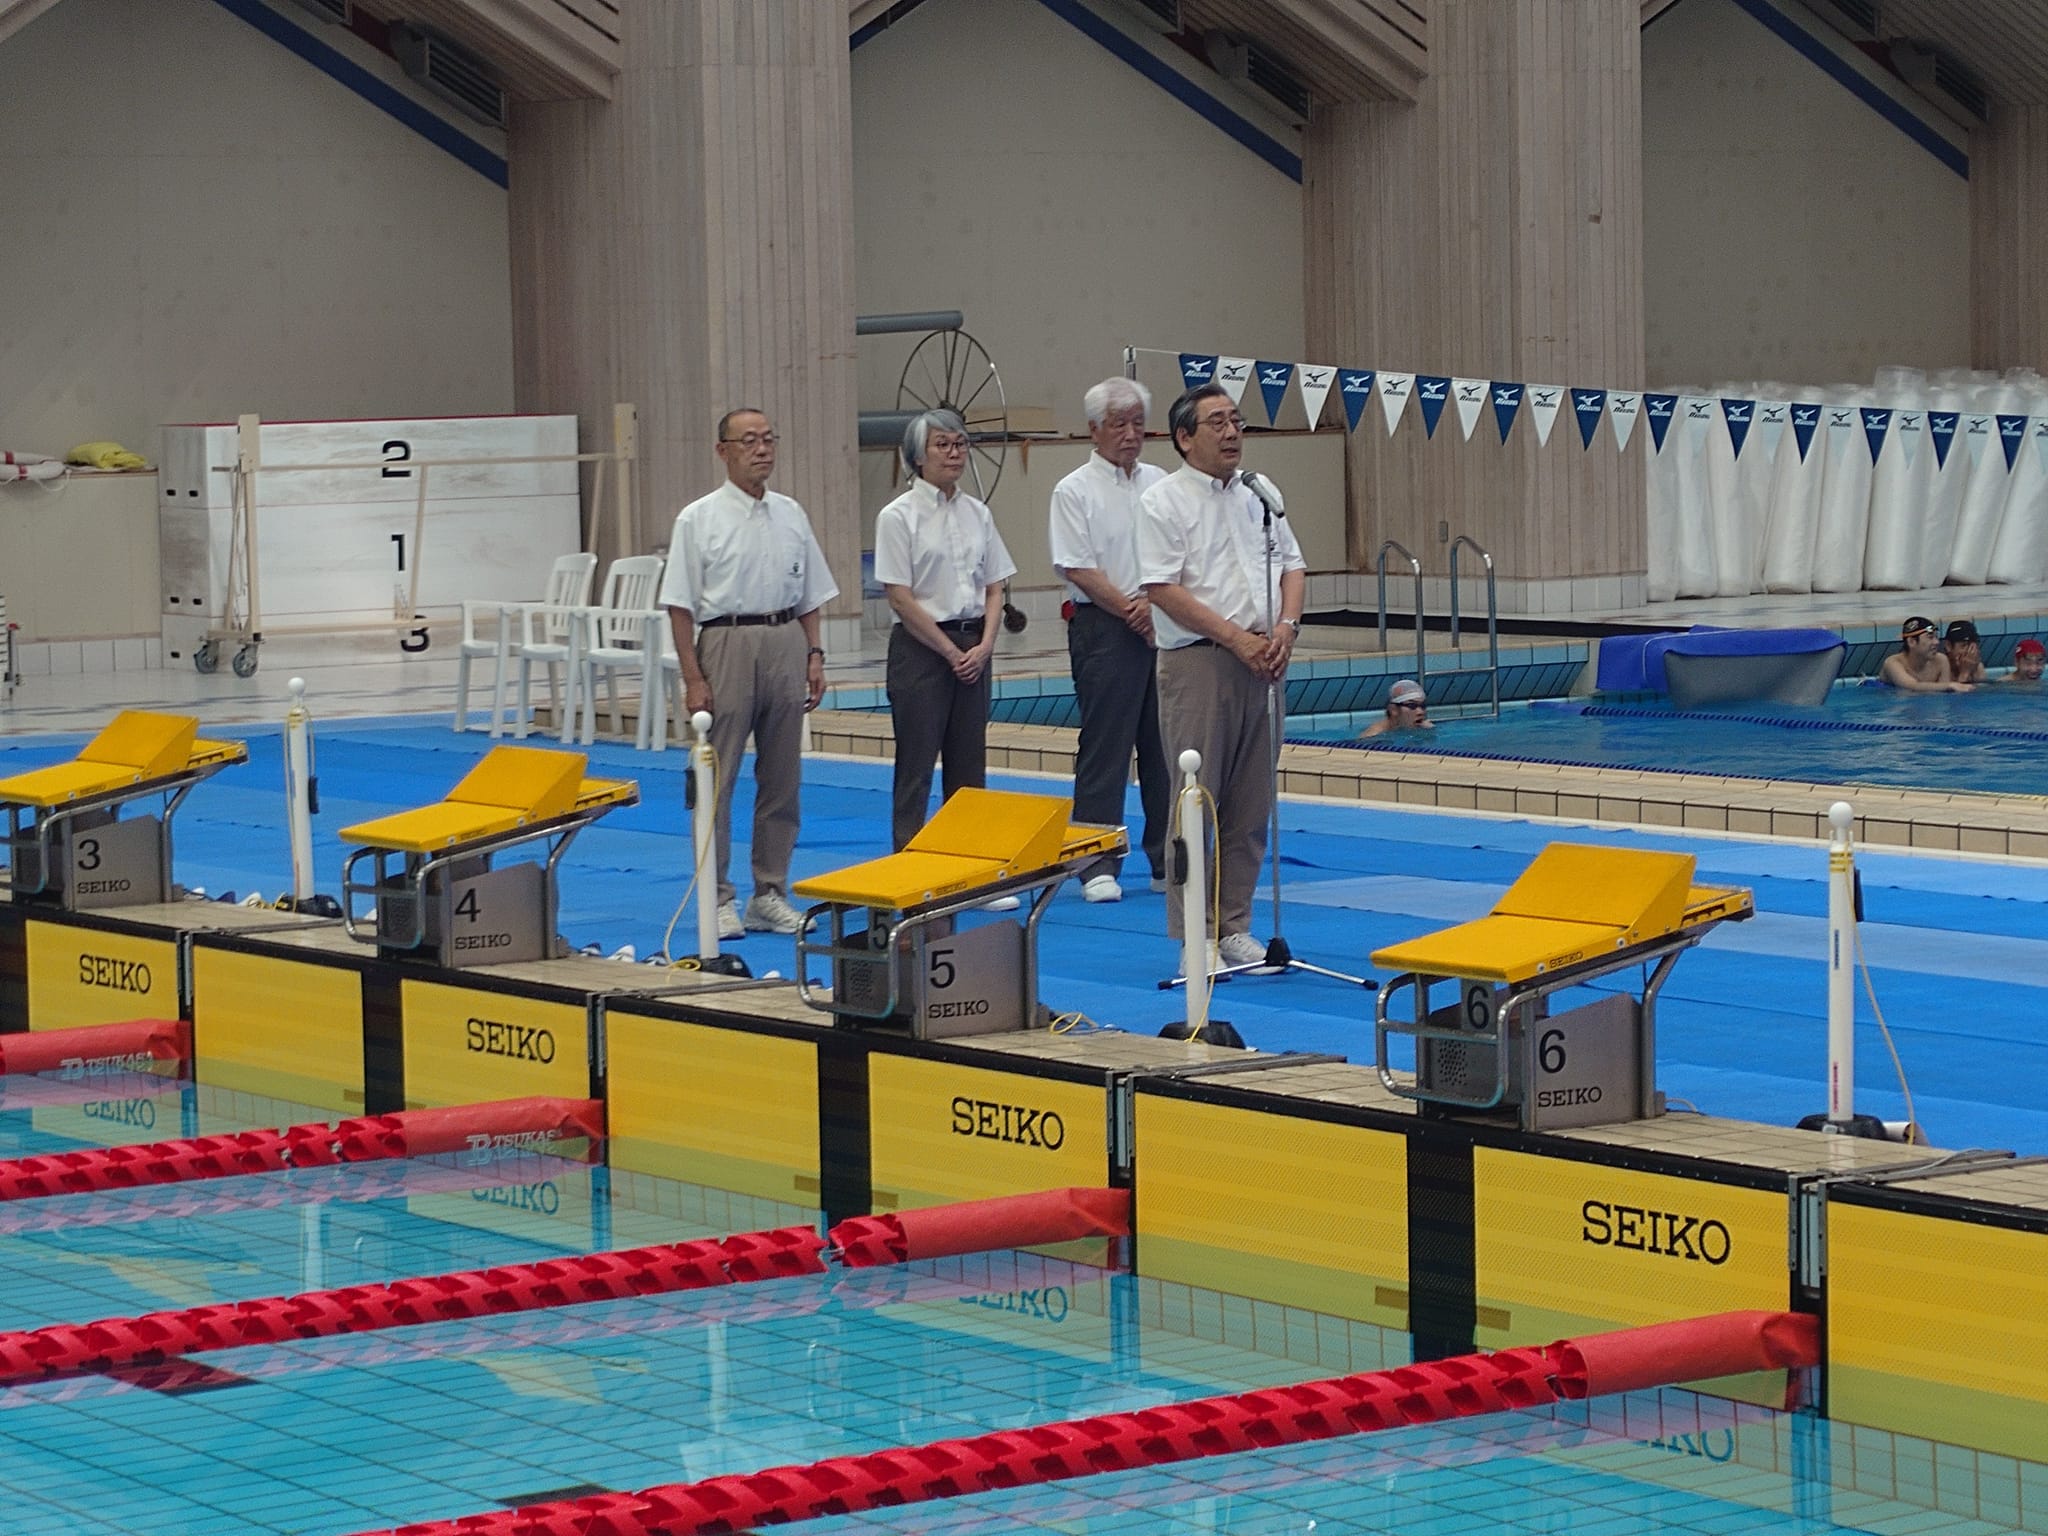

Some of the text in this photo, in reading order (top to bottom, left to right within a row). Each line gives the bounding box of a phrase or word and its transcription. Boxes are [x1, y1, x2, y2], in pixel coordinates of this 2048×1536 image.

[382, 440, 412, 478] 2
[391, 534, 406, 571] 1
[78, 839, 101, 870] 3
[77, 879, 131, 894] SEIKO
[455, 888, 481, 923] 4
[454, 933, 513, 950] SEIKO
[79, 954, 151, 996] SEIKO
[930, 950, 955, 989] 5
[928, 999, 989, 1019] SEIKO
[1467, 986, 1491, 1031] 6
[466, 1018, 556, 1065] SEIKO
[1539, 1029, 1566, 1074] 6
[1537, 1086, 1603, 1109] SEIKO
[951, 1096, 1065, 1150] SEIKO
[1583, 1200, 1732, 1266] SEIKO
